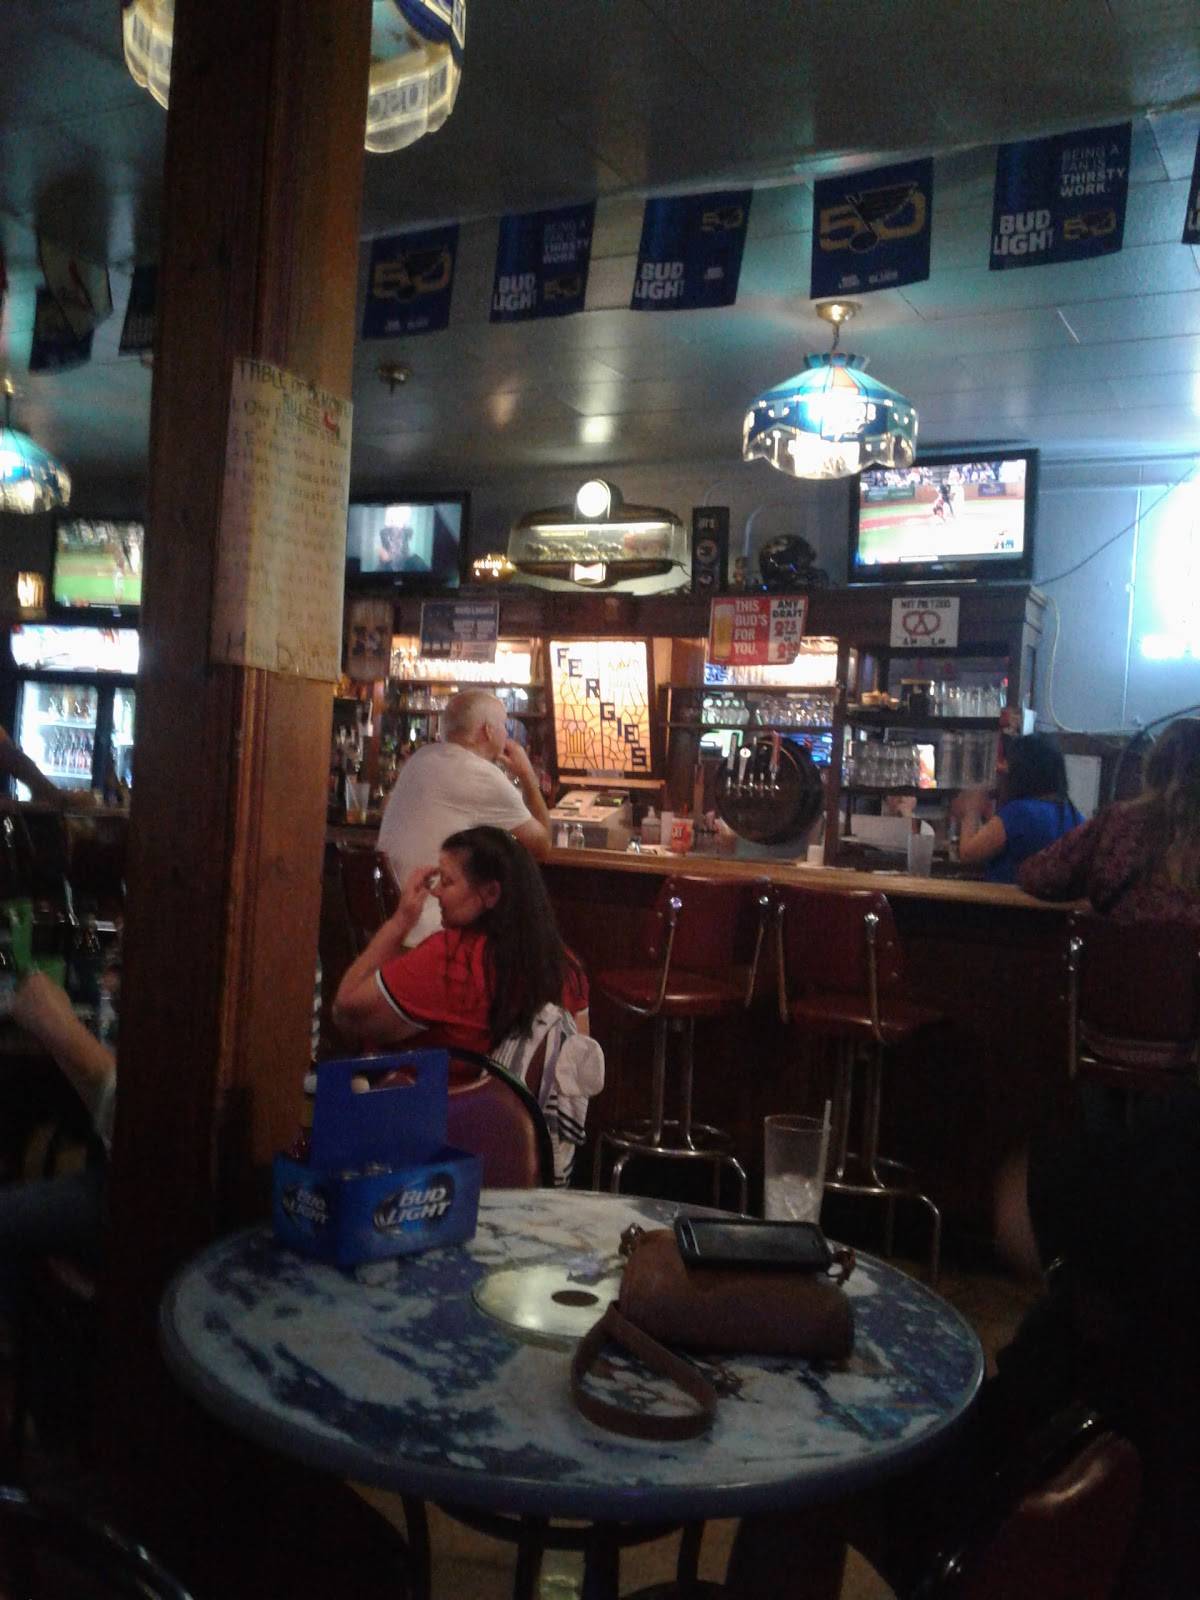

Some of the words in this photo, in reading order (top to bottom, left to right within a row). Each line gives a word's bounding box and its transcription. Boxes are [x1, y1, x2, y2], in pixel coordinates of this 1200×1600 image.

[1062, 167, 1126, 185] THIRSTY
[1000, 209, 1051, 235] BUD
[993, 227, 1055, 256] LIGHT
[641, 261, 684, 281] BUD
[499, 273, 537, 294] BUD
[634, 279, 686, 300] LIGHT
[494, 289, 538, 311] LIGHT
[735, 600, 760, 612] THIS
[772, 609, 802, 619] DRAFT
[777, 600, 799, 609] ANY
[735, 614, 768, 627] BUD'S
[735, 628, 756, 641] FOR
[557, 647, 647, 767] FERGIES
[399, 1186, 447, 1208] BUD
[386, 1202, 452, 1227] LIGHT
